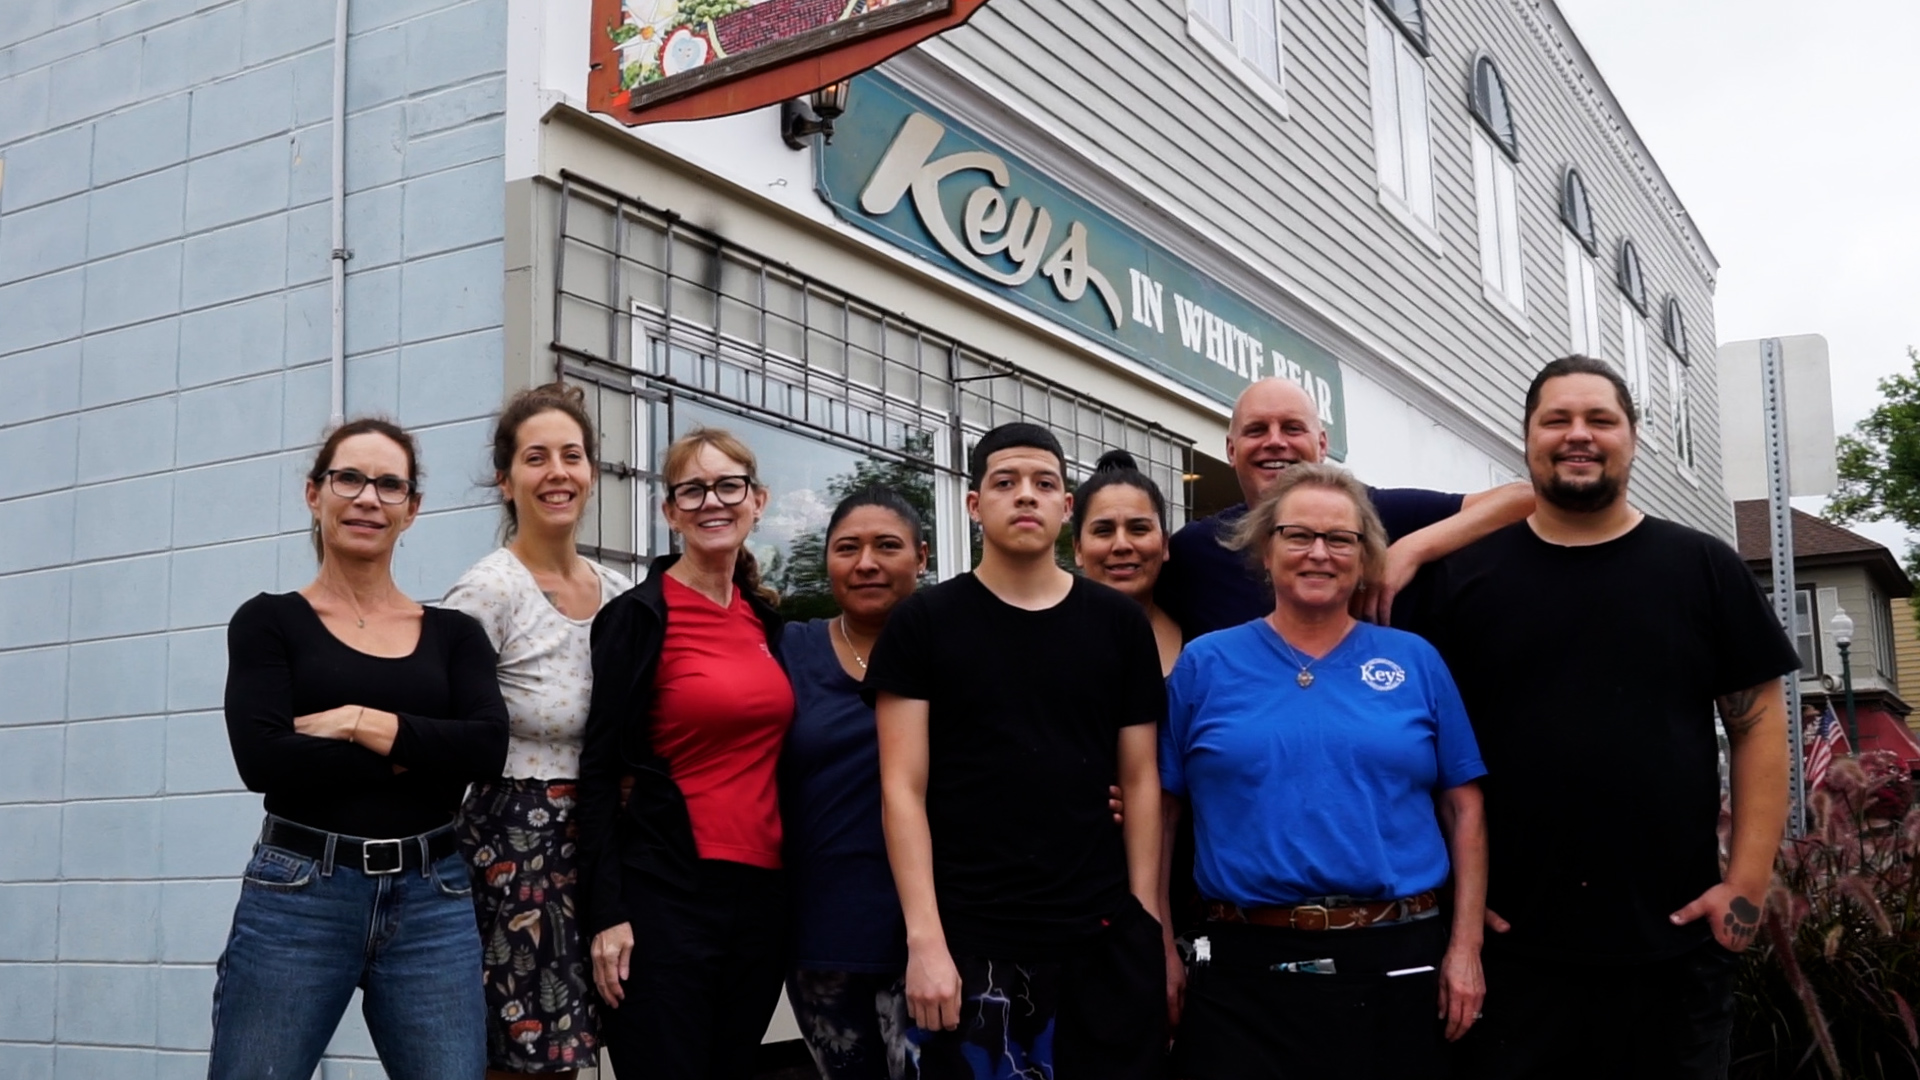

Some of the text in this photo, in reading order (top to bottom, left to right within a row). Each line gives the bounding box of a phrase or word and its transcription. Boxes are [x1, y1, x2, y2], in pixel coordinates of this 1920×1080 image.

[860, 112, 1123, 329] Keys
[1129, 268, 1165, 334] IN
[1173, 293, 1265, 383] WHITE
[1360, 664, 1406, 686] Keys
